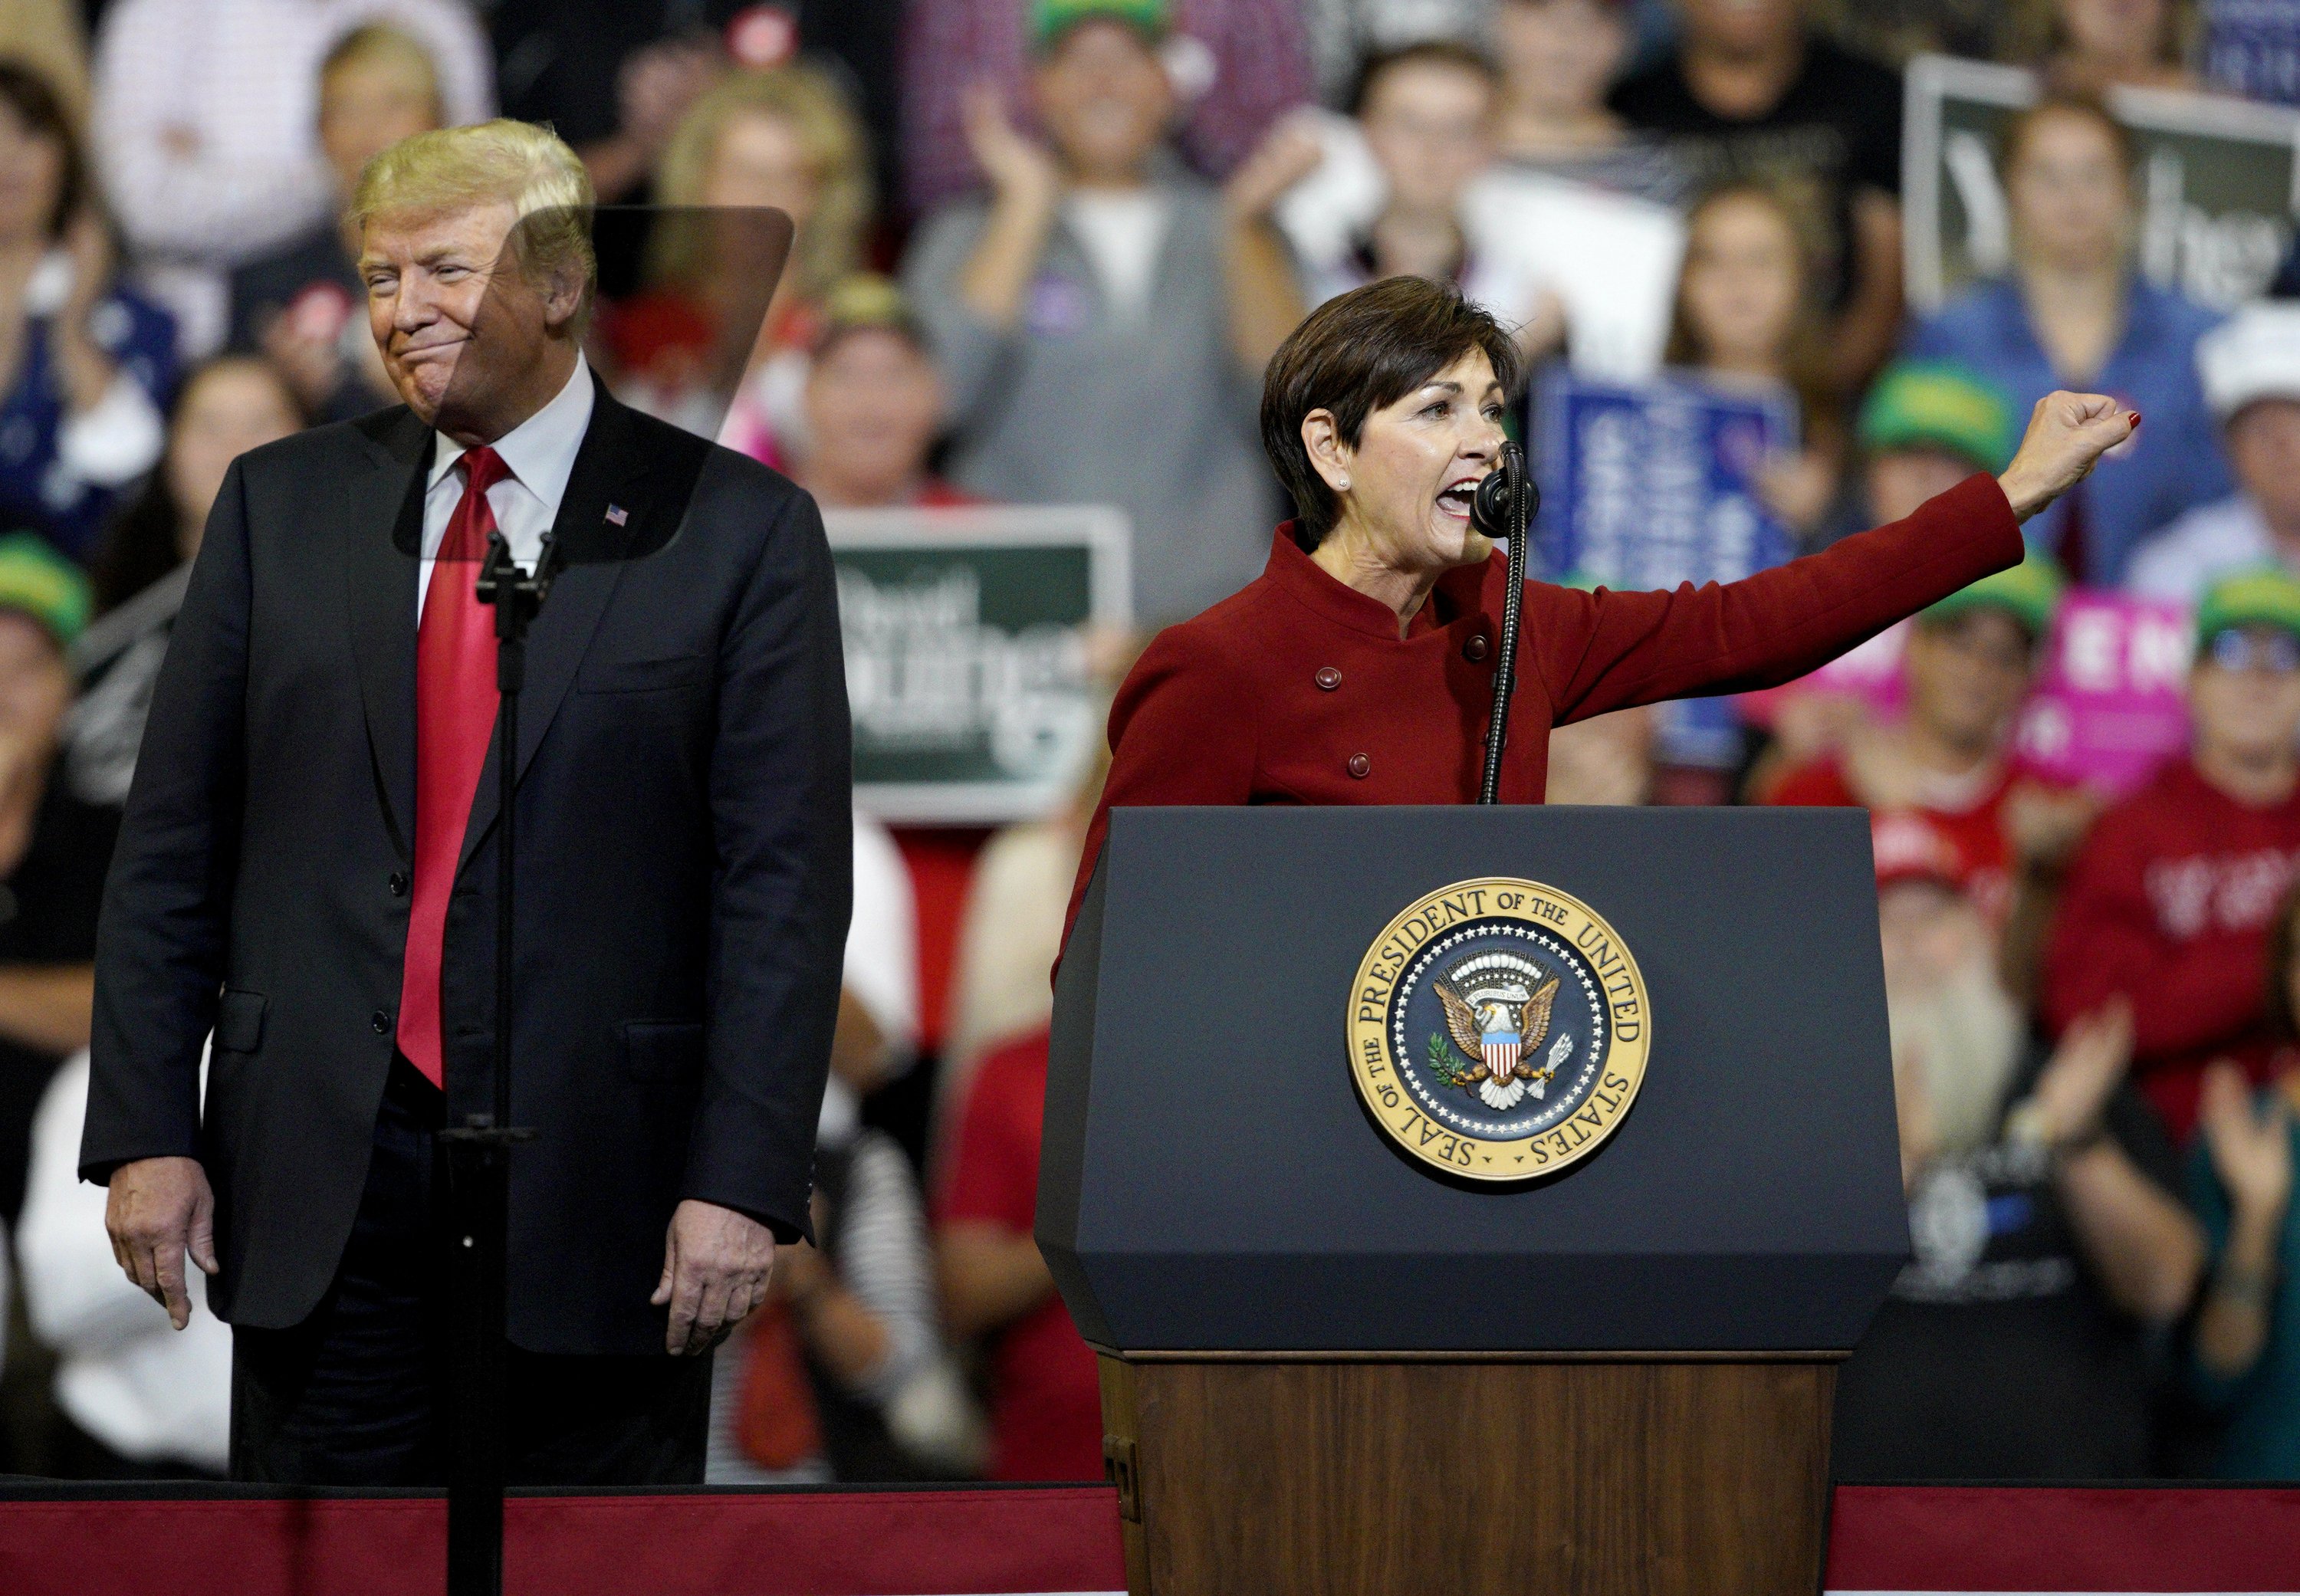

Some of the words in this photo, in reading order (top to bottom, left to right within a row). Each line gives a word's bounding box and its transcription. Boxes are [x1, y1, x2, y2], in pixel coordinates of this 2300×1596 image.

[1497, 892, 1525, 910] OF
[1531, 896, 1569, 926] THE
[1359, 888, 1487, 1025] PRESIDENT
[1506, 991, 1527, 1000] UNUM
[1576, 921, 1640, 1043] UNITED
[1362, 1037, 1385, 1078] THE
[1375, 1082, 1399, 1108] OF
[1400, 1105, 1476, 1166] SEAL
[1530, 1071, 1629, 1164] STATES
